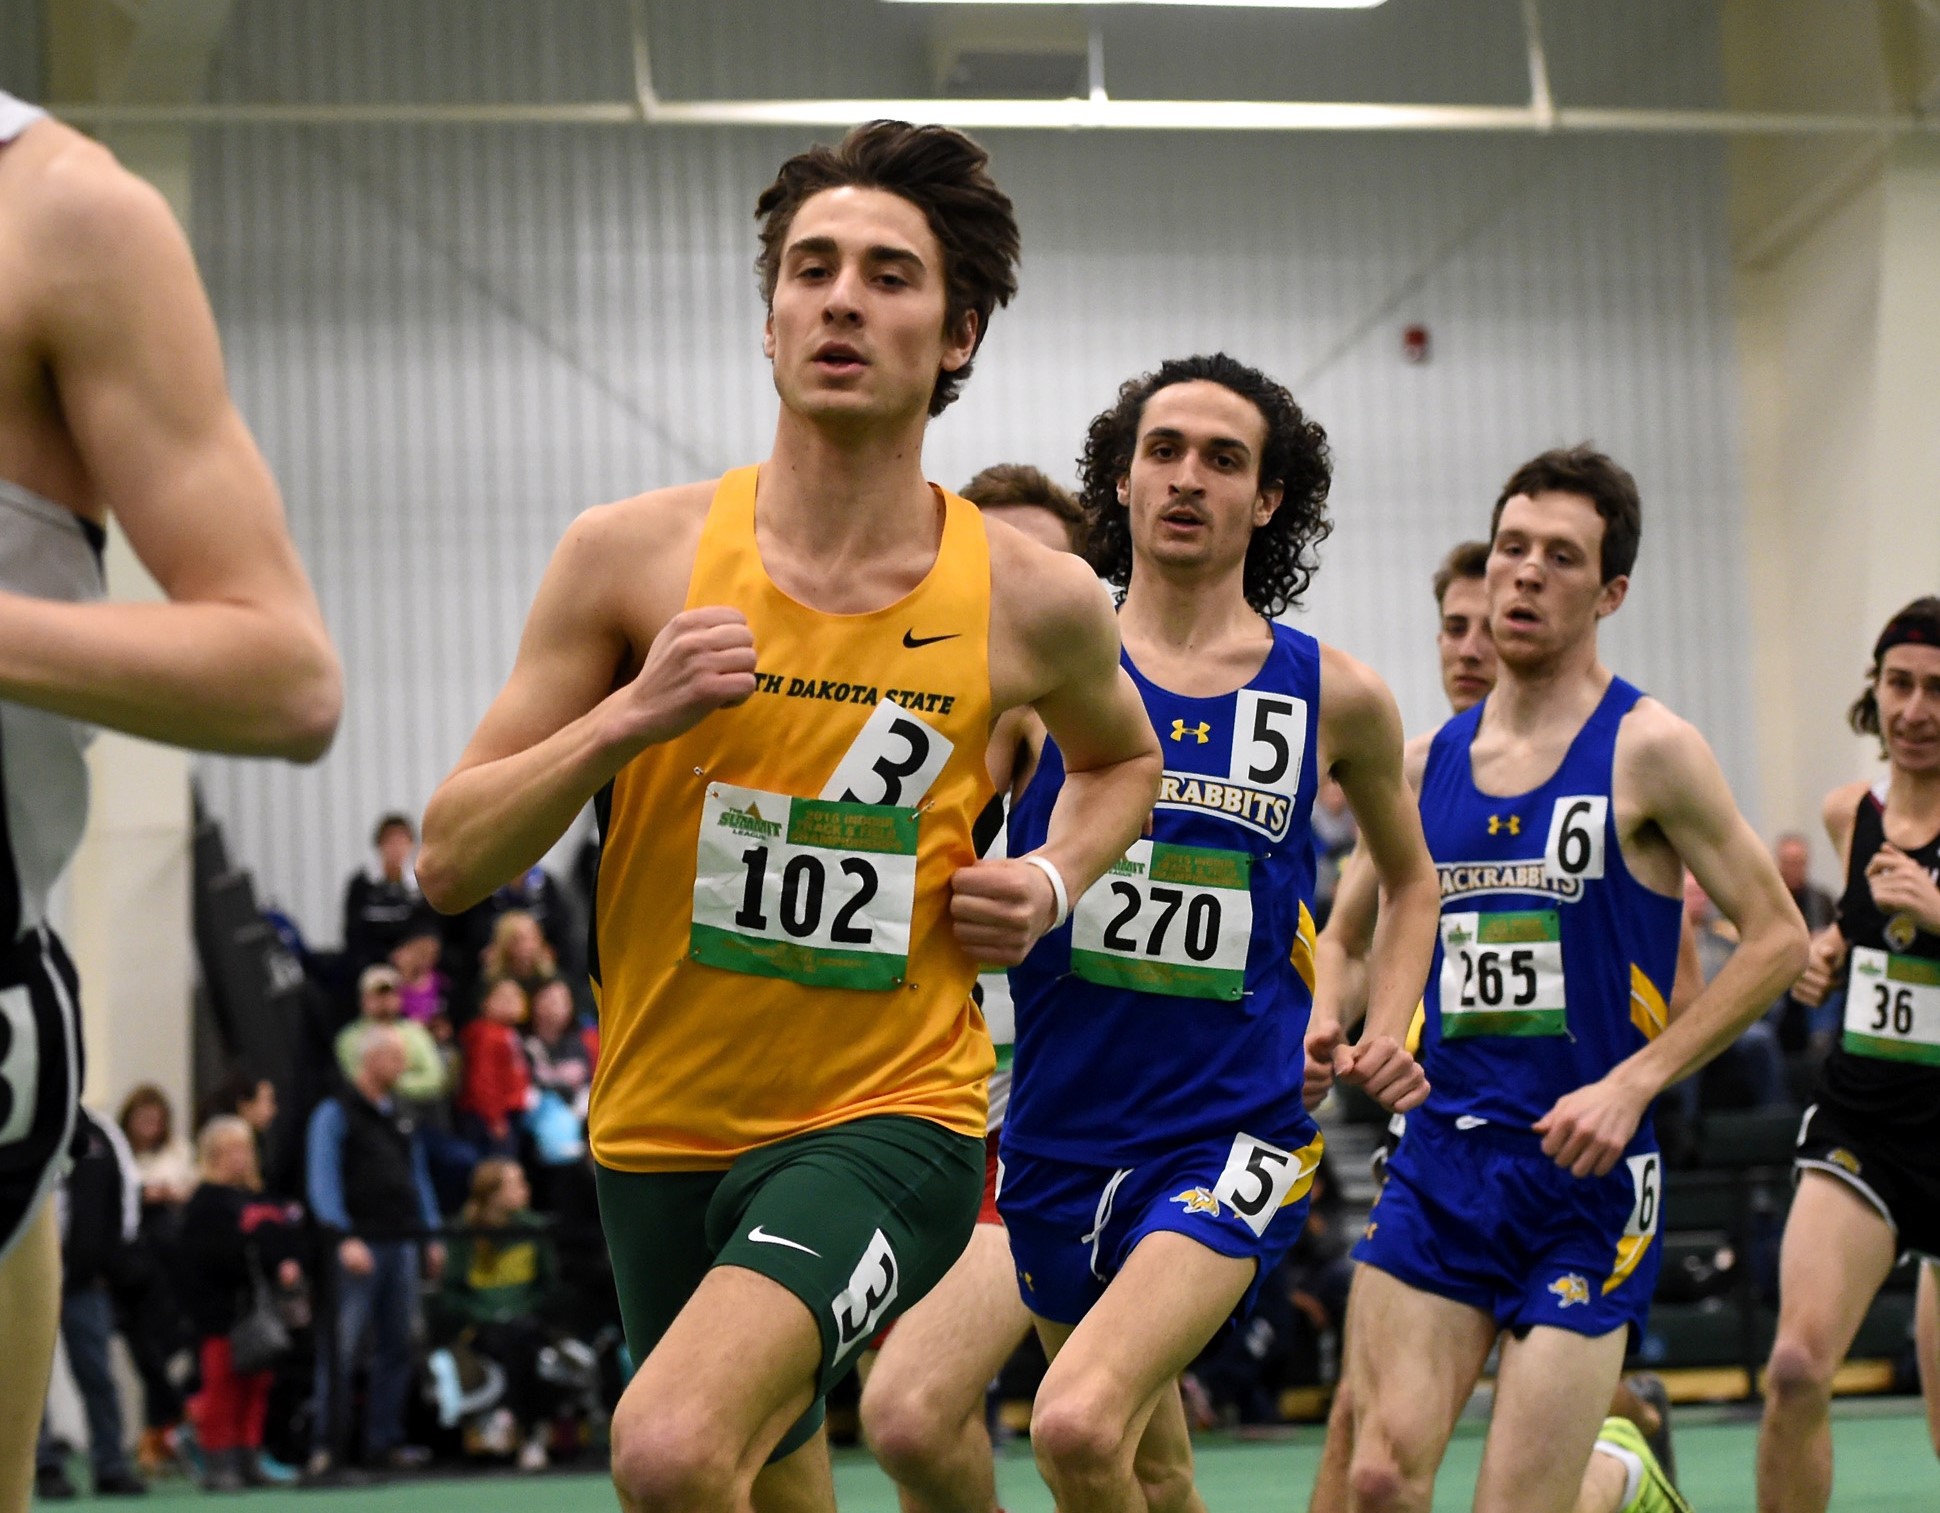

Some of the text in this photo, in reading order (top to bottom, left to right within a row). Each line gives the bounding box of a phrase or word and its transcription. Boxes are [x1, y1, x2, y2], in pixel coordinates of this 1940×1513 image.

[786, 678, 878, 707] DAKOTA
[884, 688, 956, 715] STATE
[838, 718, 930, 807] 3
[1248, 698, 1293, 784] 5
[717, 811, 782, 837] SUMMIT
[1558, 801, 1592, 874] 6
[735, 846, 878, 944] 102
[1104, 881, 1222, 961] 270
[1460, 951, 1537, 1006] 265
[1871, 984, 1913, 1034] 36
[1230, 1146, 1289, 1216] 5
[1639, 1159, 1656, 1231] 6
[842, 1253, 894, 1343] 3
